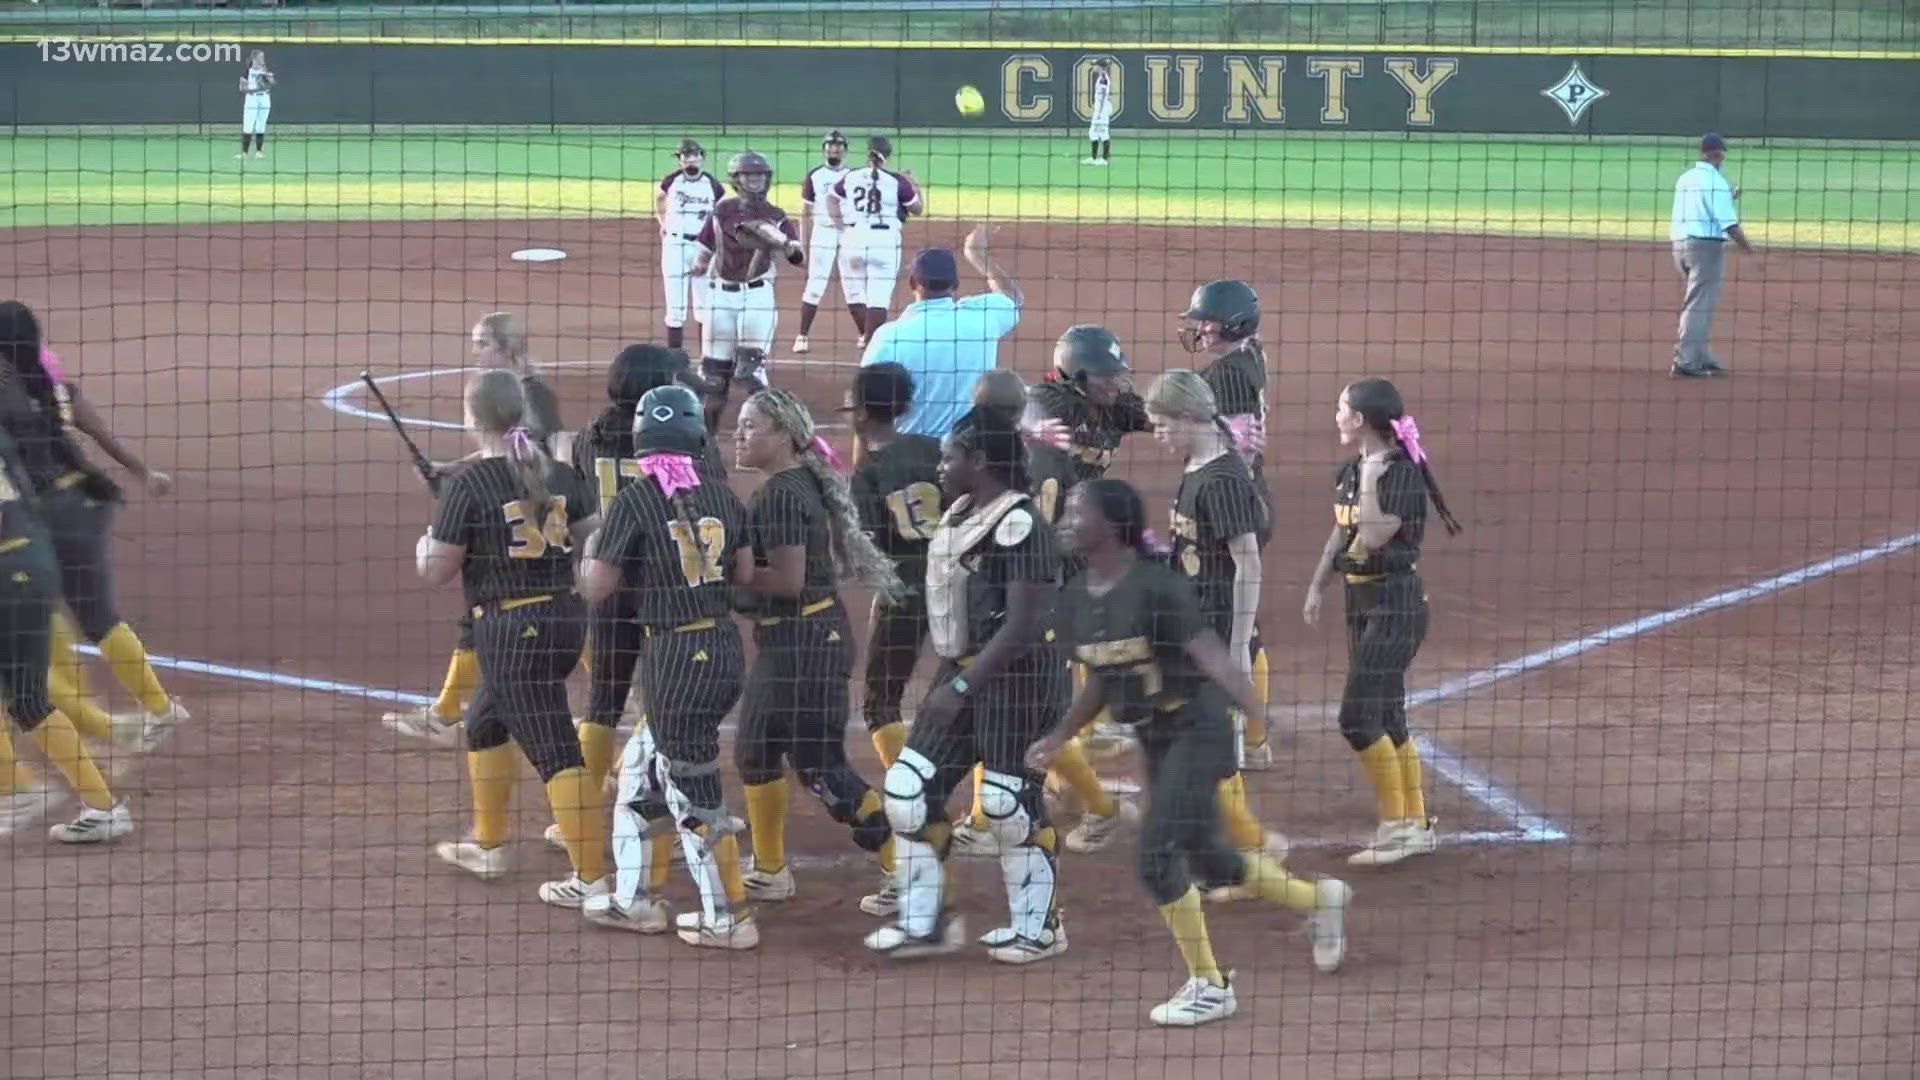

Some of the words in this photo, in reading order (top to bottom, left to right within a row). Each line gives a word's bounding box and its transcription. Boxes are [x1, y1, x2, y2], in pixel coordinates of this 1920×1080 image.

[1001, 54, 1459, 127] COUNTY
[1567, 85, 1586, 103] P
[853, 185, 882, 214] 28
[668, 516, 725, 587] 12
